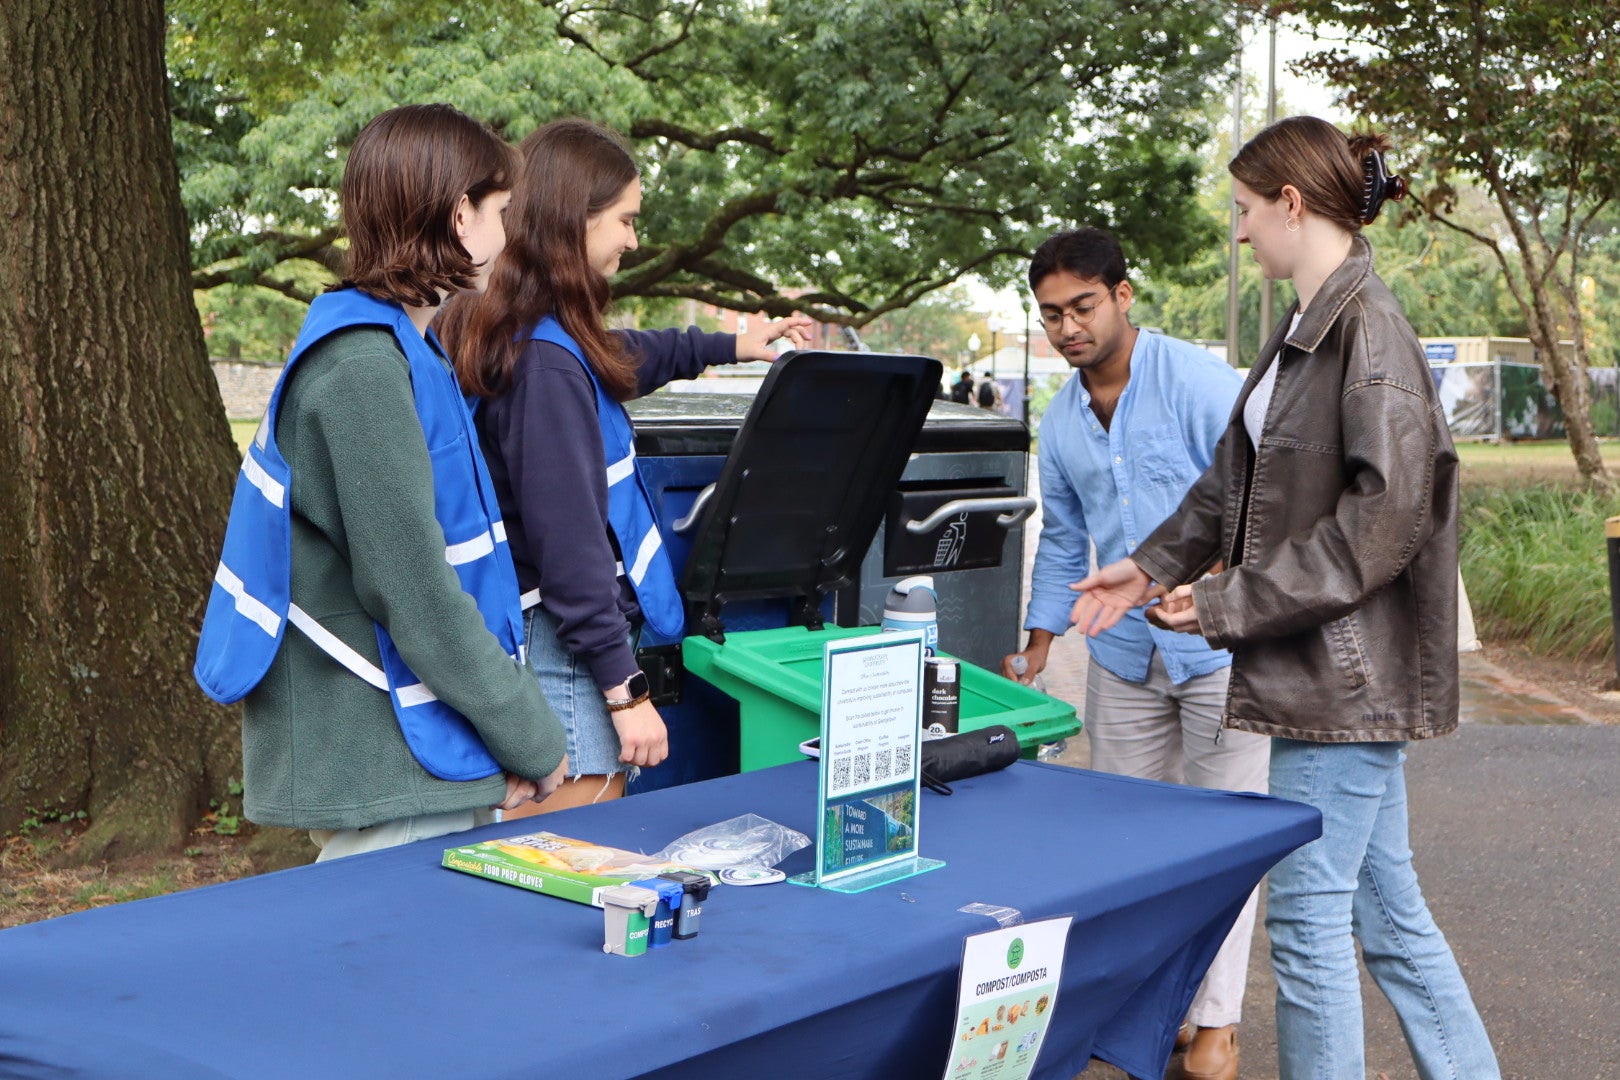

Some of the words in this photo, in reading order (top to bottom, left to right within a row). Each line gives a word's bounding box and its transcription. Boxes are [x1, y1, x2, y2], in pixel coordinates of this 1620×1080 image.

[932, 687, 947, 695] dark
[845, 804, 867, 820] TOWARD
[845, 824, 850, 834] A
[850, 824, 864, 835] MORE
[447, 852, 482, 874] Compostable
[484, 863, 500, 877] FOOD
[502, 868, 517, 881] PREP
[518, 873, 544, 888] GLOVES
[975, 966, 1048, 997] COMPOST/COMPOSTA
